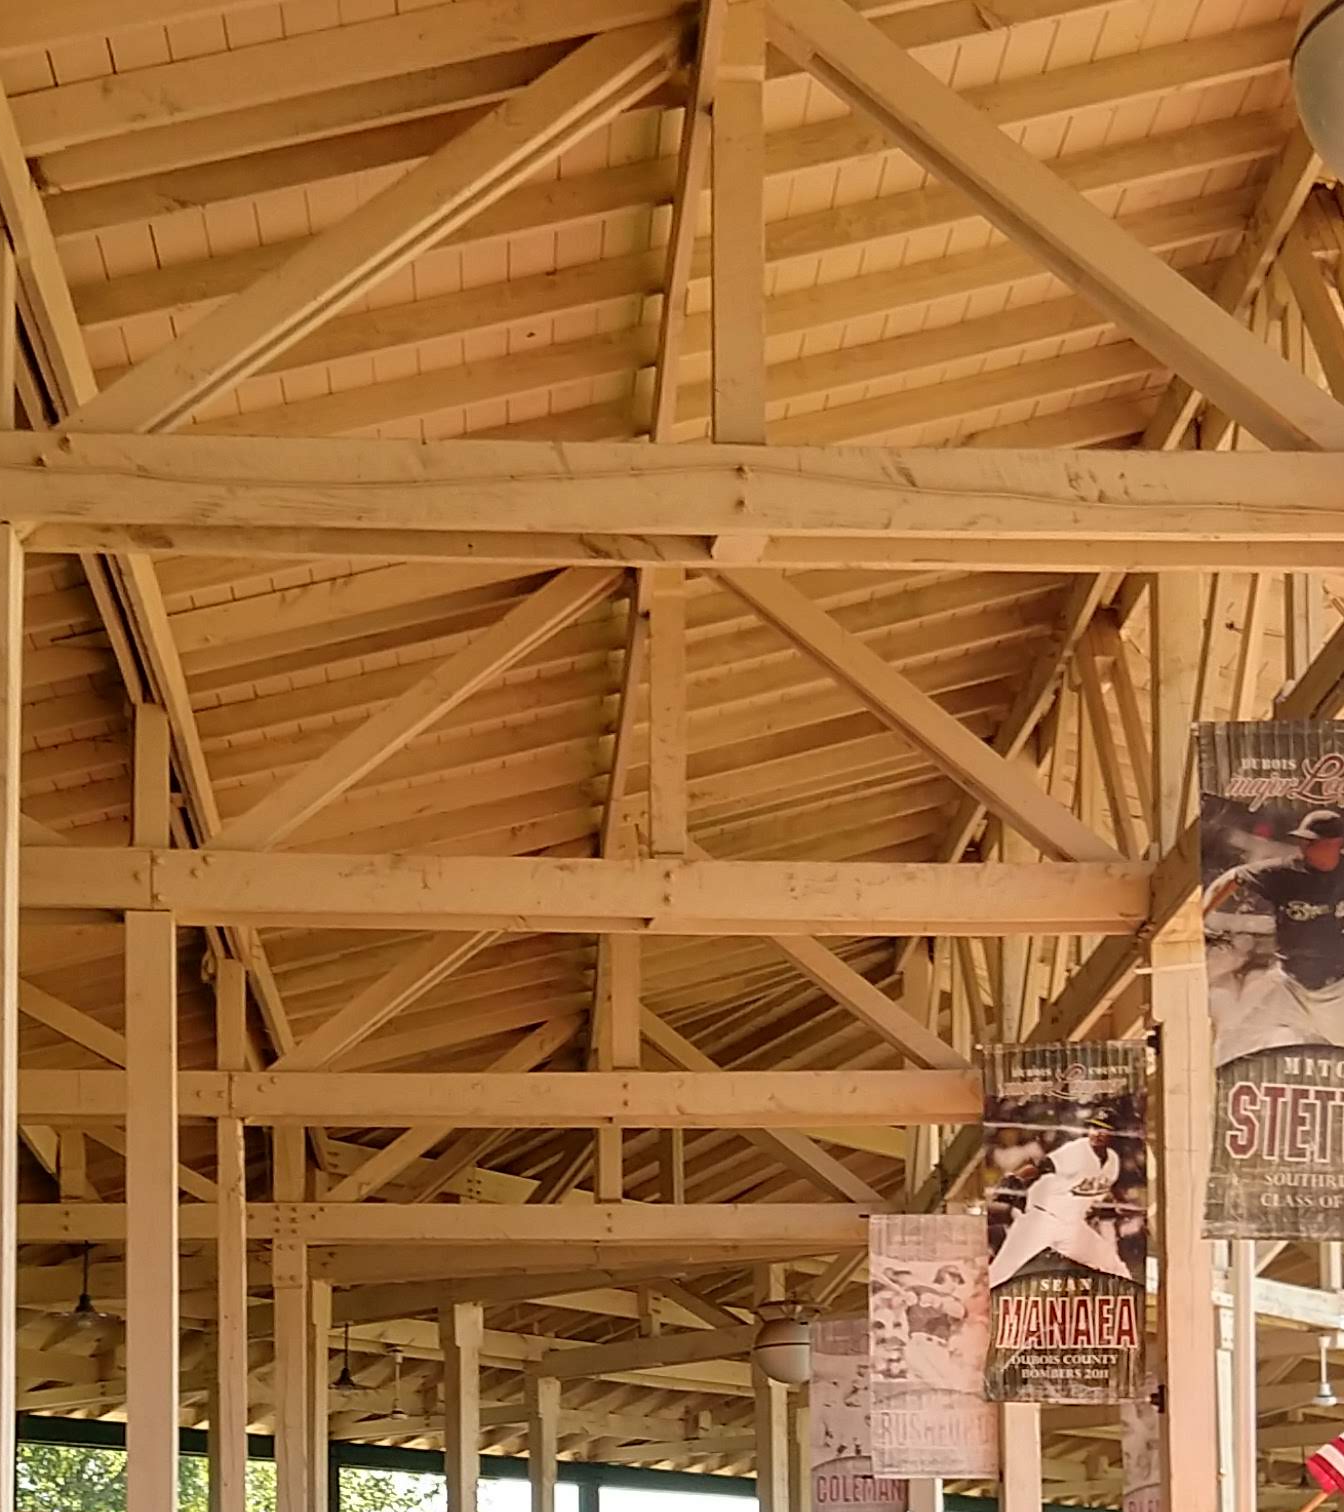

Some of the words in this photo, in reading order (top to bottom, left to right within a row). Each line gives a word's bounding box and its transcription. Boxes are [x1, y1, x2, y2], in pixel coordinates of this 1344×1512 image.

[1260, 1193, 1313, 1208] CLASS
[1319, 1195, 1344, 1208] OF
[1039, 1278, 1093, 1292] SEAN
[995, 1295, 1138, 1350] MANAEA
[1011, 1354, 1061, 1365] DUBOIS
[1063, 1354, 1118, 1365] COUNTY
[816, 1474, 905, 1504] COLEMAN
